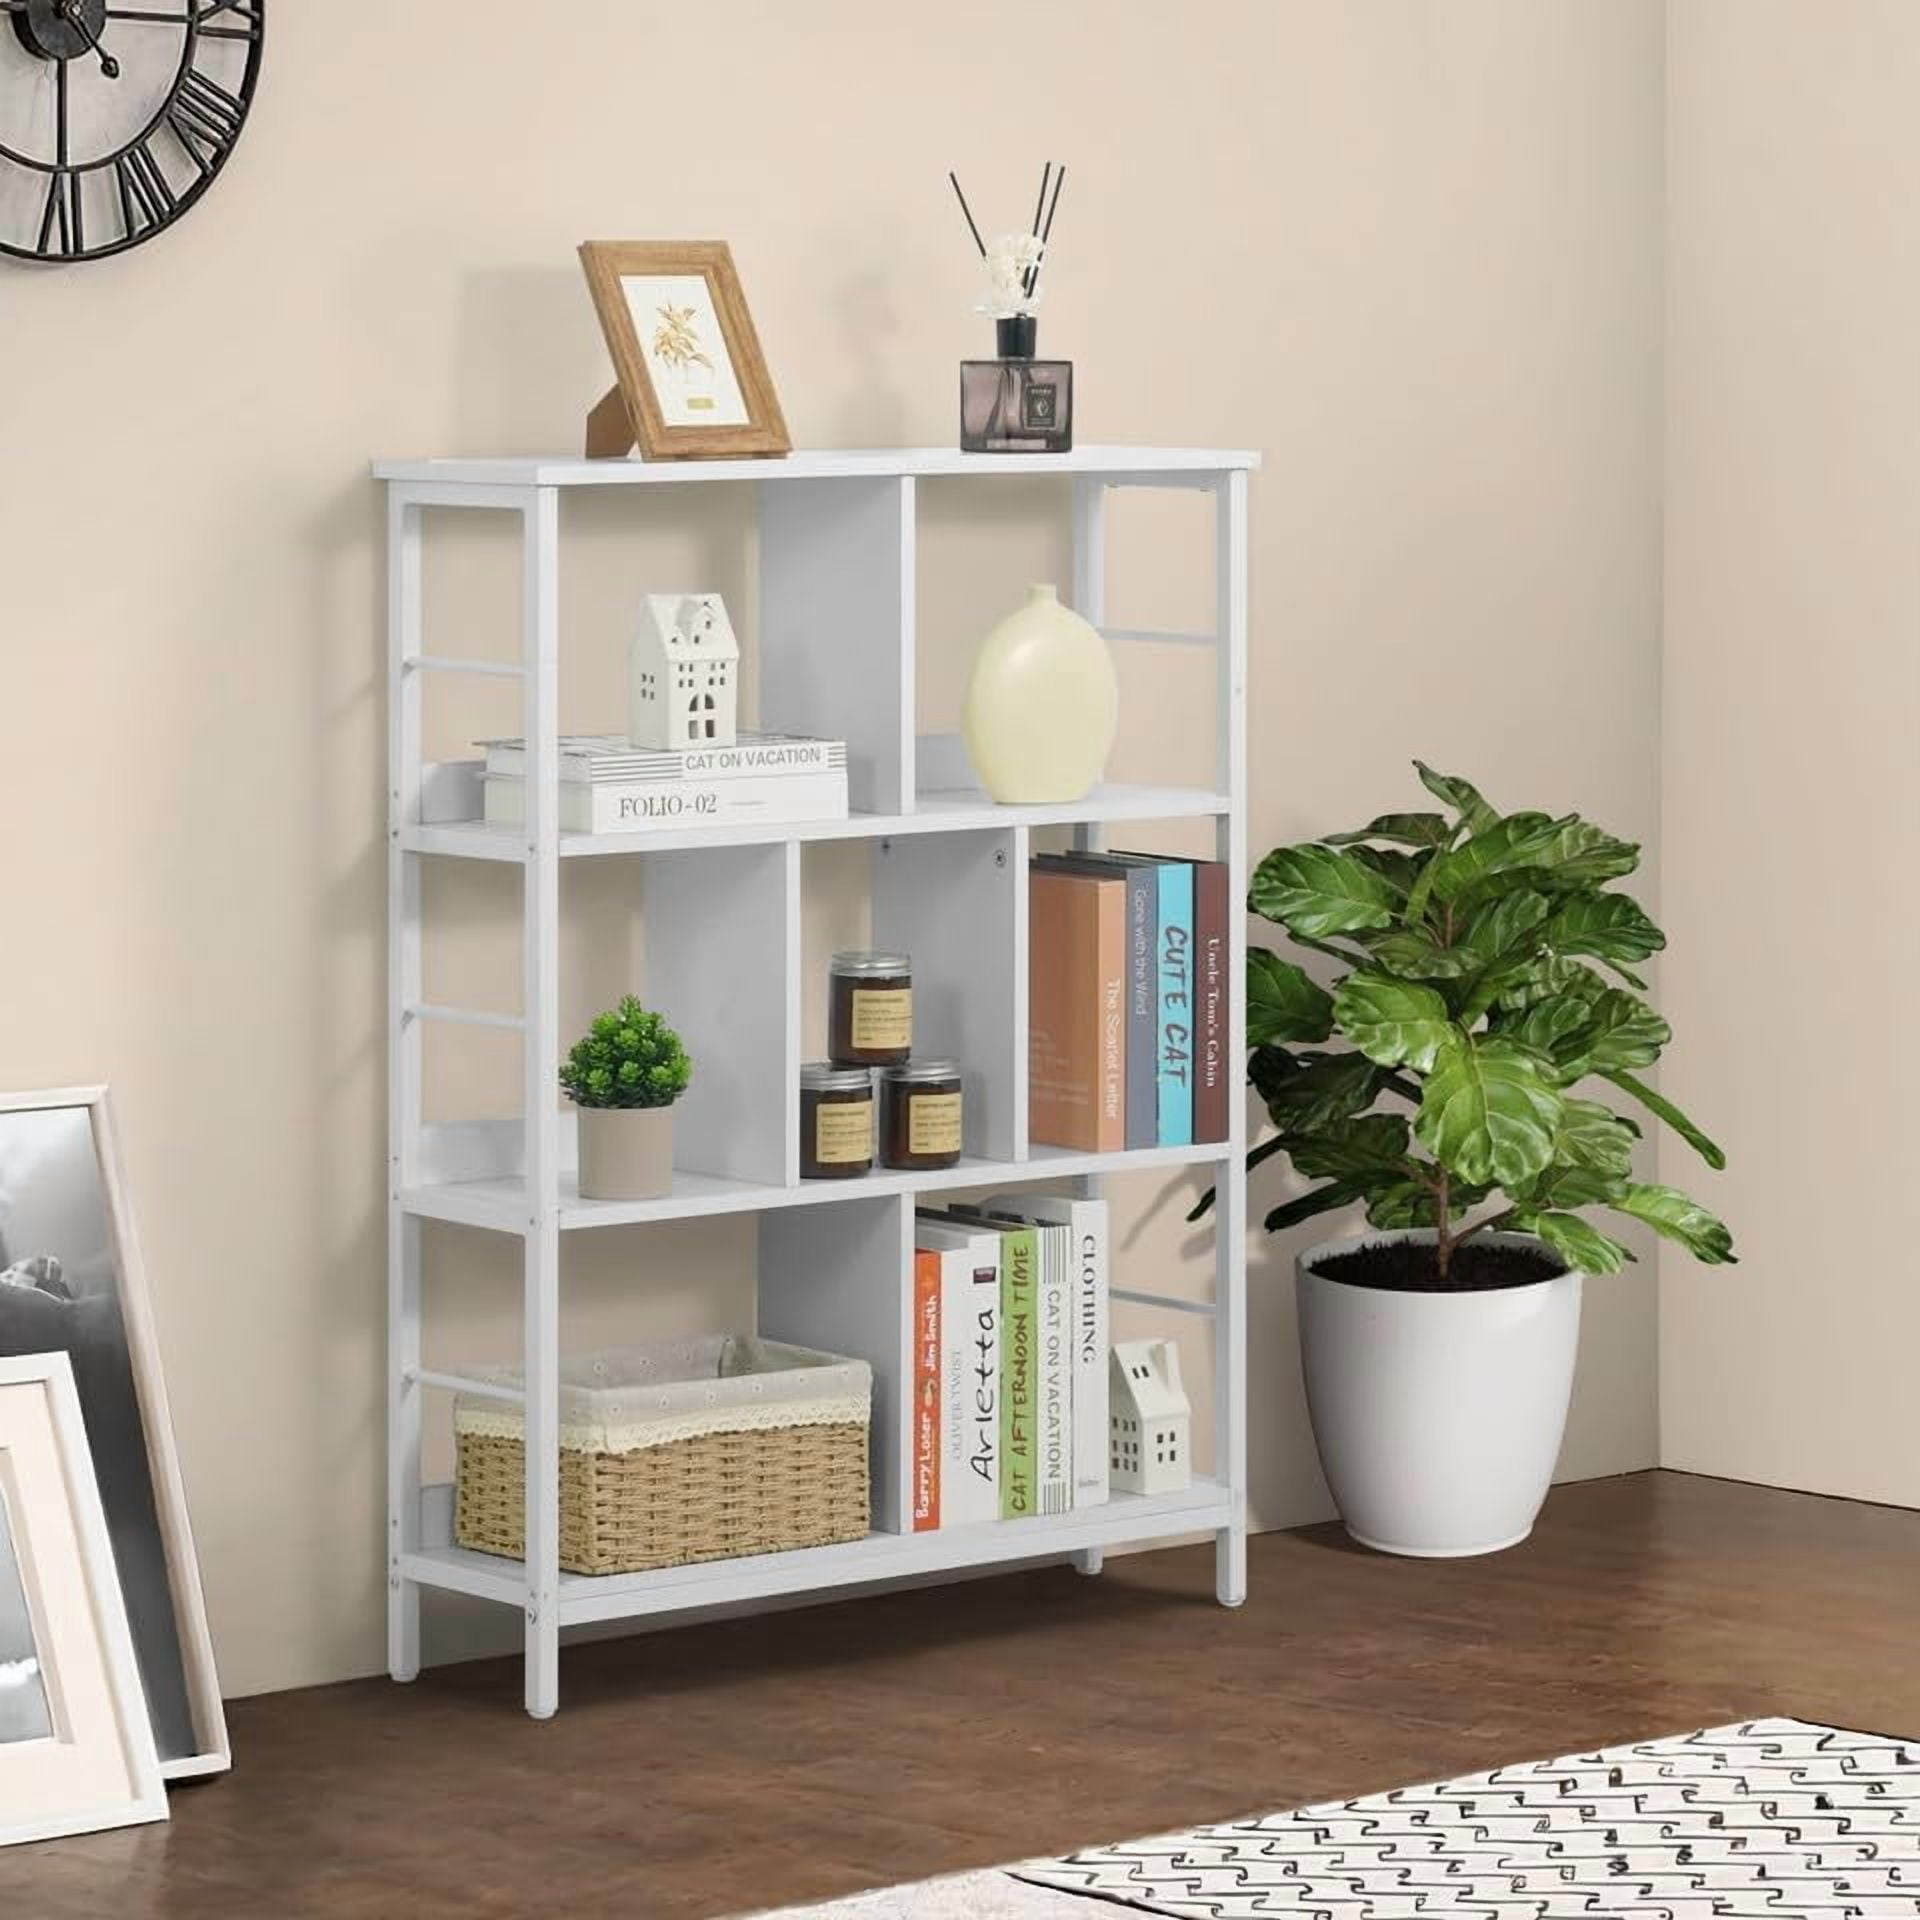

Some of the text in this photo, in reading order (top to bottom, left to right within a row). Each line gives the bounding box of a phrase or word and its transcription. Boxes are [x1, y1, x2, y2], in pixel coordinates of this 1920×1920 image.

[619, 793, 717, 819] FOLIO-02
[686, 747, 821, 770] CAT ON VACATION
[1135, 889, 1148, 1016] Gone with the Wind
[1163, 925, 1189, 1088] CUTE CAT
[1206, 938, 1220, 1088] Uncle Tom's Cabin
[1105, 978, 1121, 1119] The Scarlet Letter
[923, 1294, 938, 1372] Jim Smith
[1082, 1234, 1097, 1364] CLOTHING
[970, 1308, 994, 1483] Arletta
[1010, 1246, 1029, 1512] CAT AFTERNOON TIME
[1047, 1289, 1061, 1479] CAT ON VACATION
[915, 1411, 932, 1519] Barry Loser
